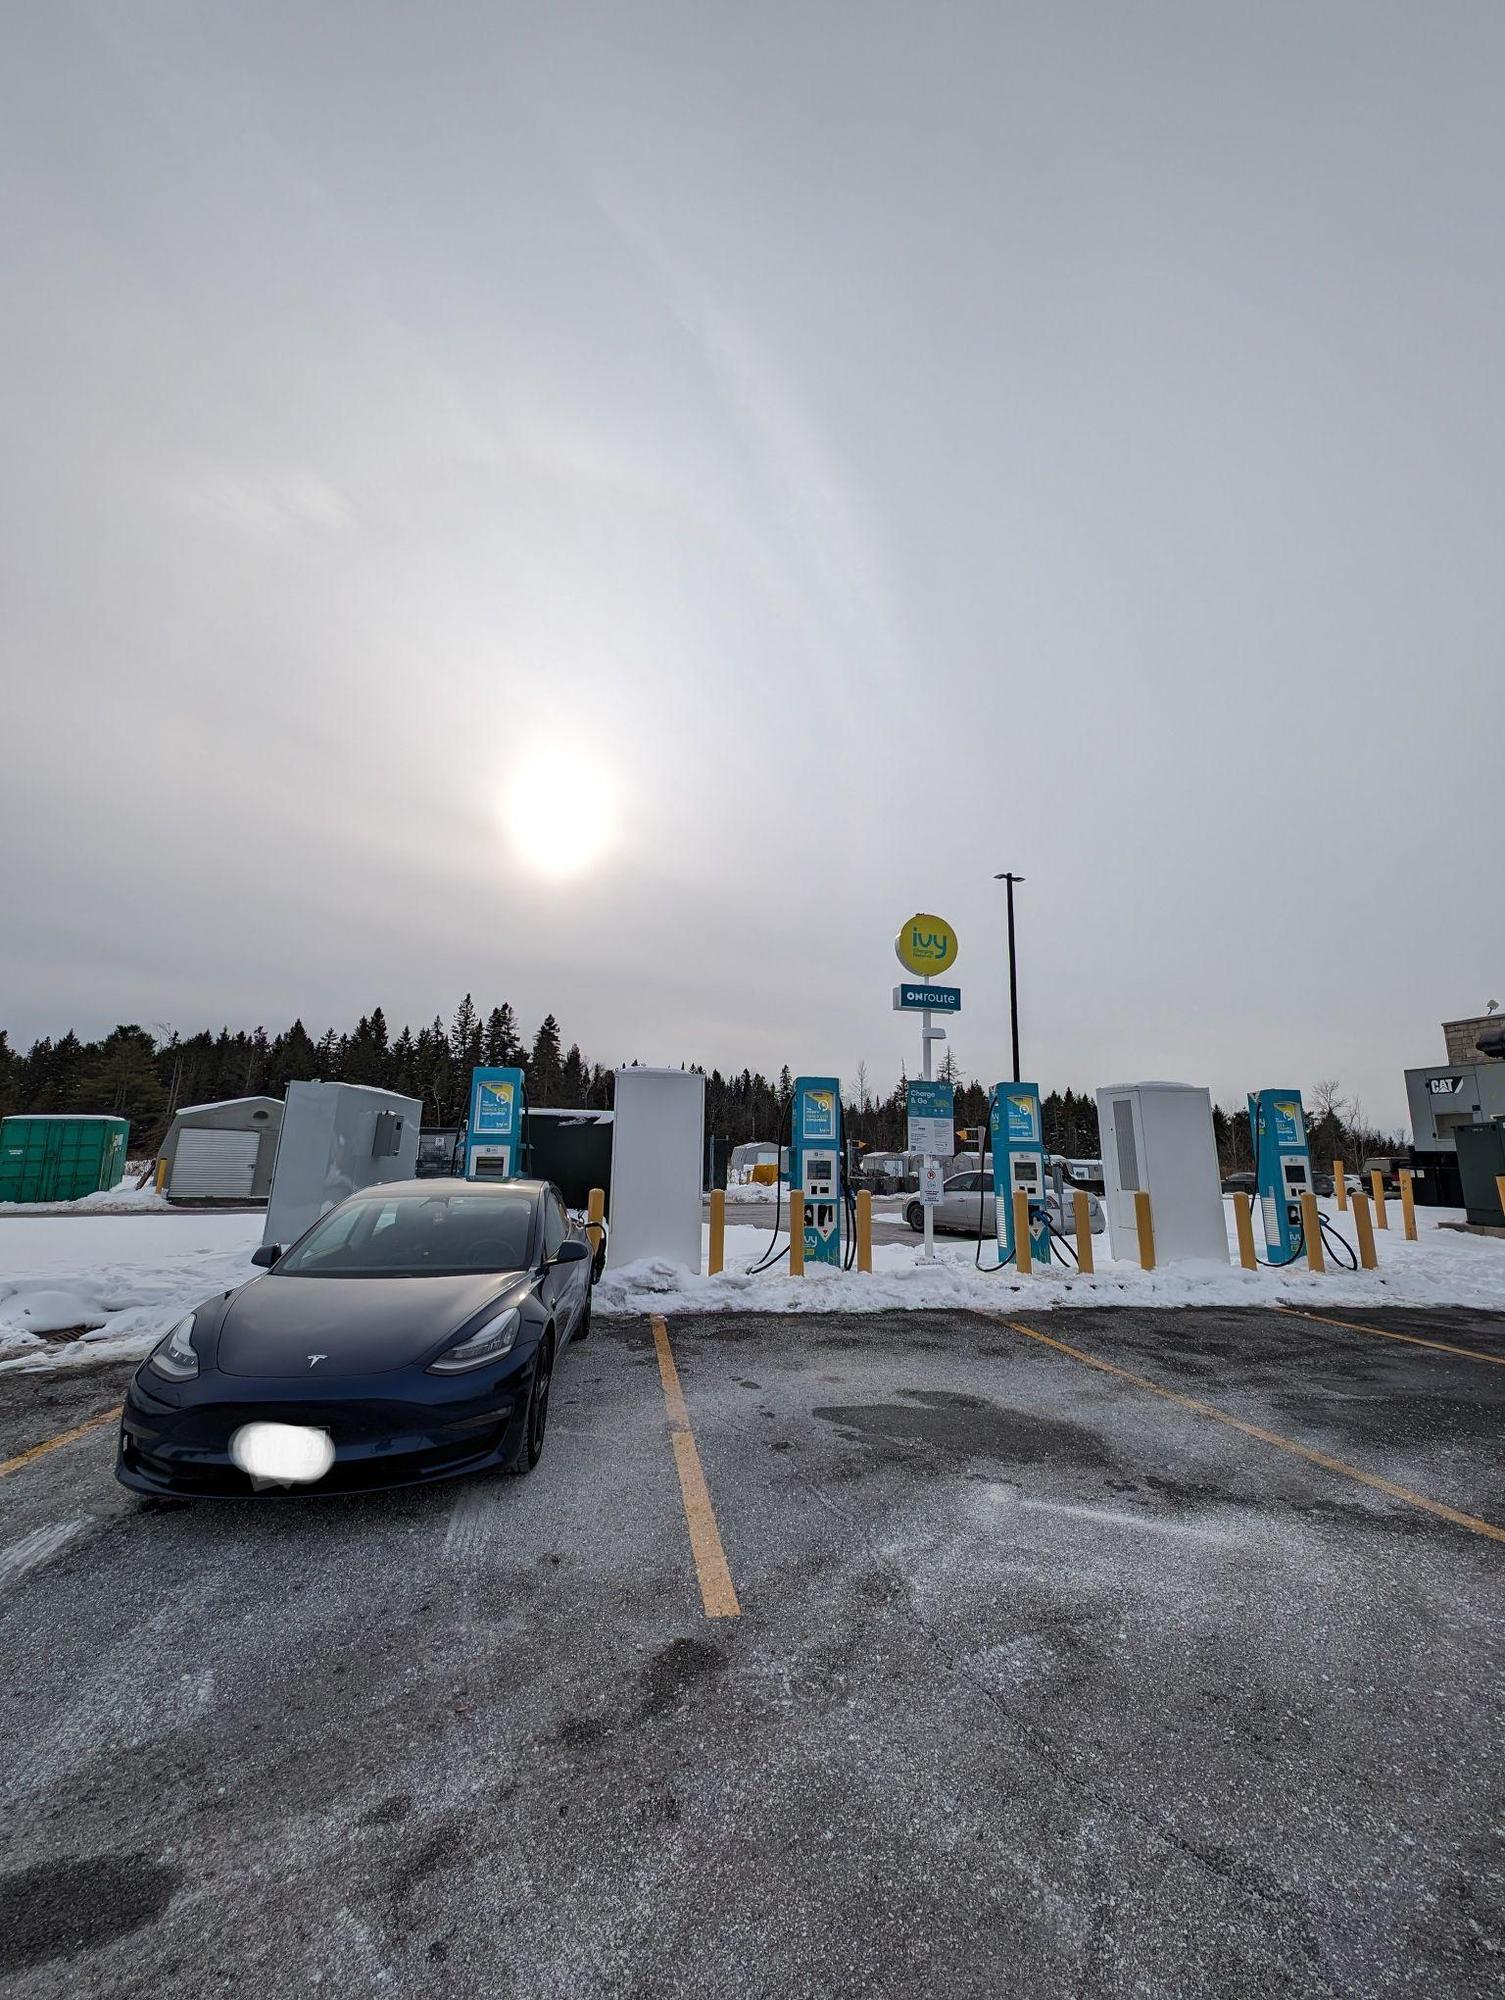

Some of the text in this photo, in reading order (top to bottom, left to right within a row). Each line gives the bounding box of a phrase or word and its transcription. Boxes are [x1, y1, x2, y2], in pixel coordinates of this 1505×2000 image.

[912, 927, 947, 960] ivy
[906, 991, 956, 1004] ONroute
[1431, 1078, 1453, 1094] CAT
[910, 1089, 936, 1099] Charge
[917, 1097, 928, 1105] Go
[803, 1235, 817, 1248] vy
